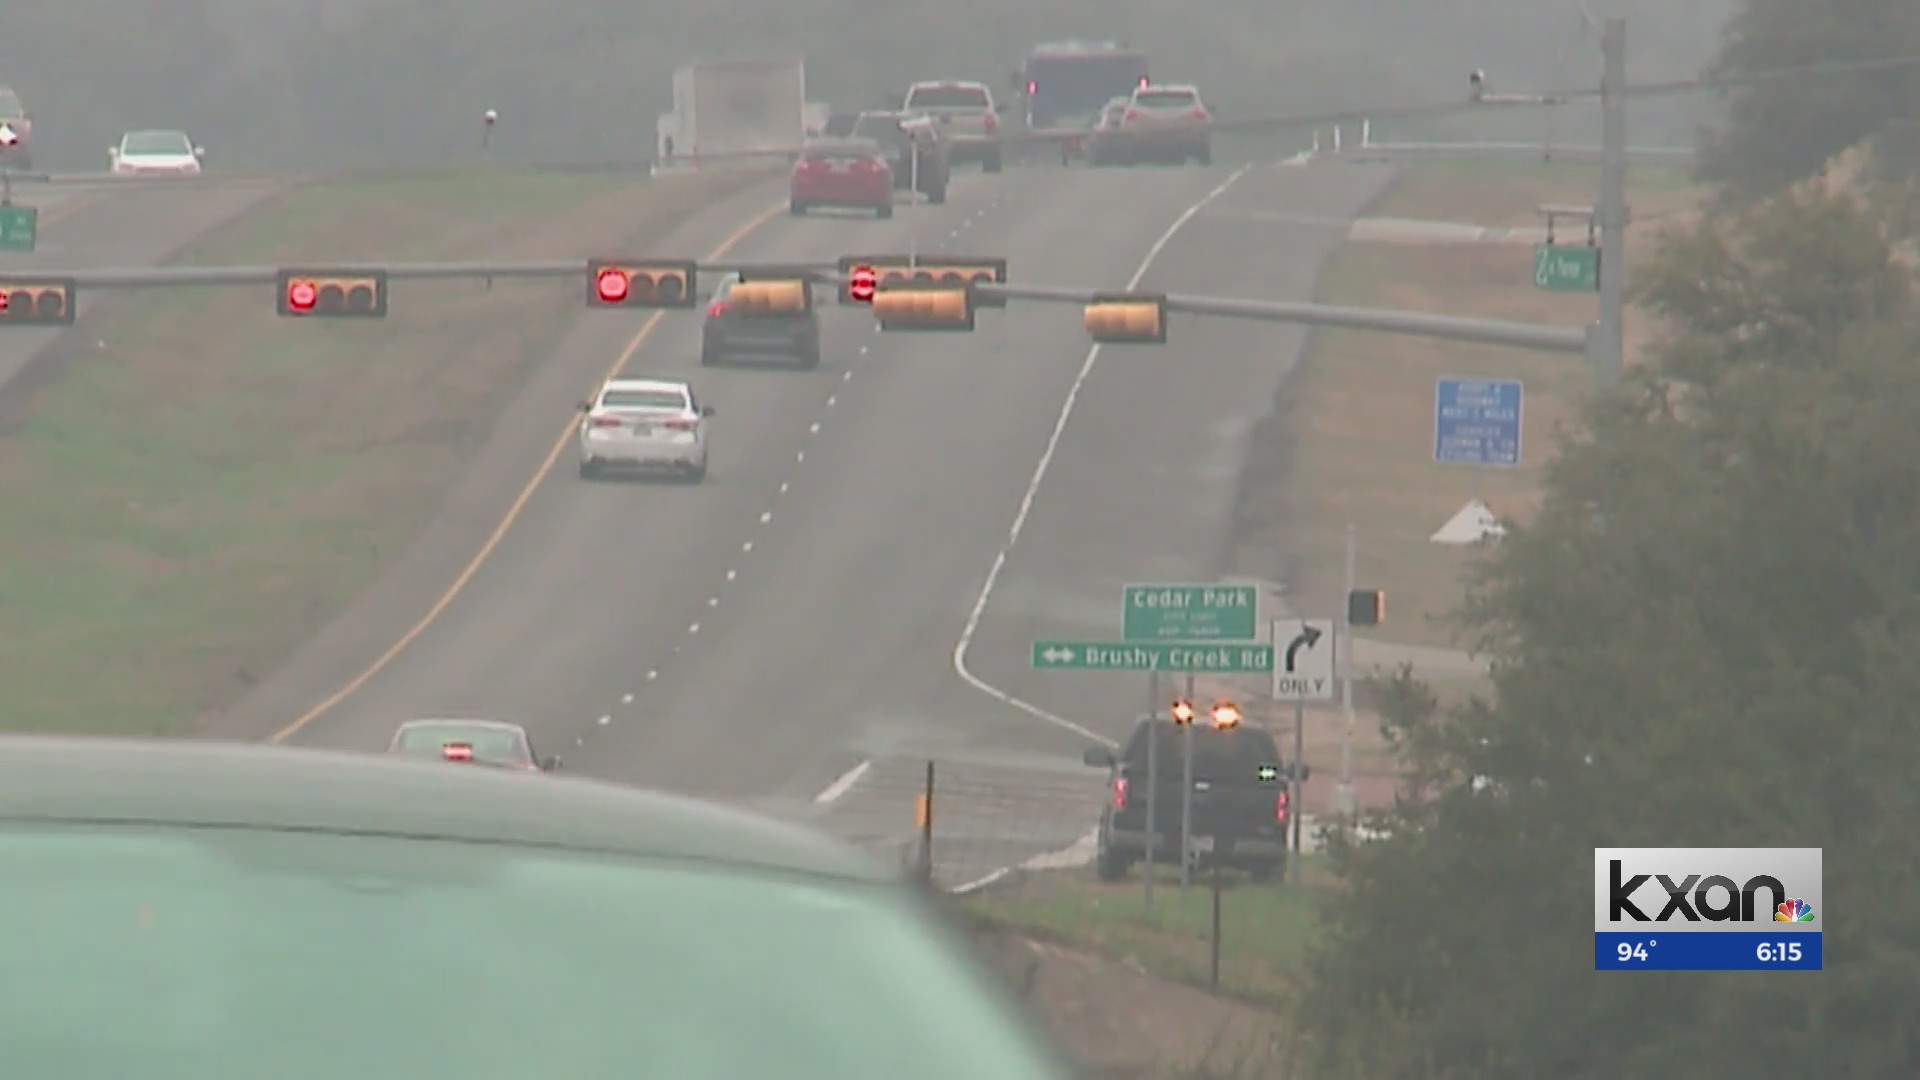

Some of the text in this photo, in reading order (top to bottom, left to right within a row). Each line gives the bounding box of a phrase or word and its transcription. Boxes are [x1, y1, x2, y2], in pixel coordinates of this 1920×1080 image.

[1134, 590, 1248, 607] Cedar Park
[1086, 647, 1268, 670] Brushy Creek Rd
[1280, 678, 1324, 695] ONLY
